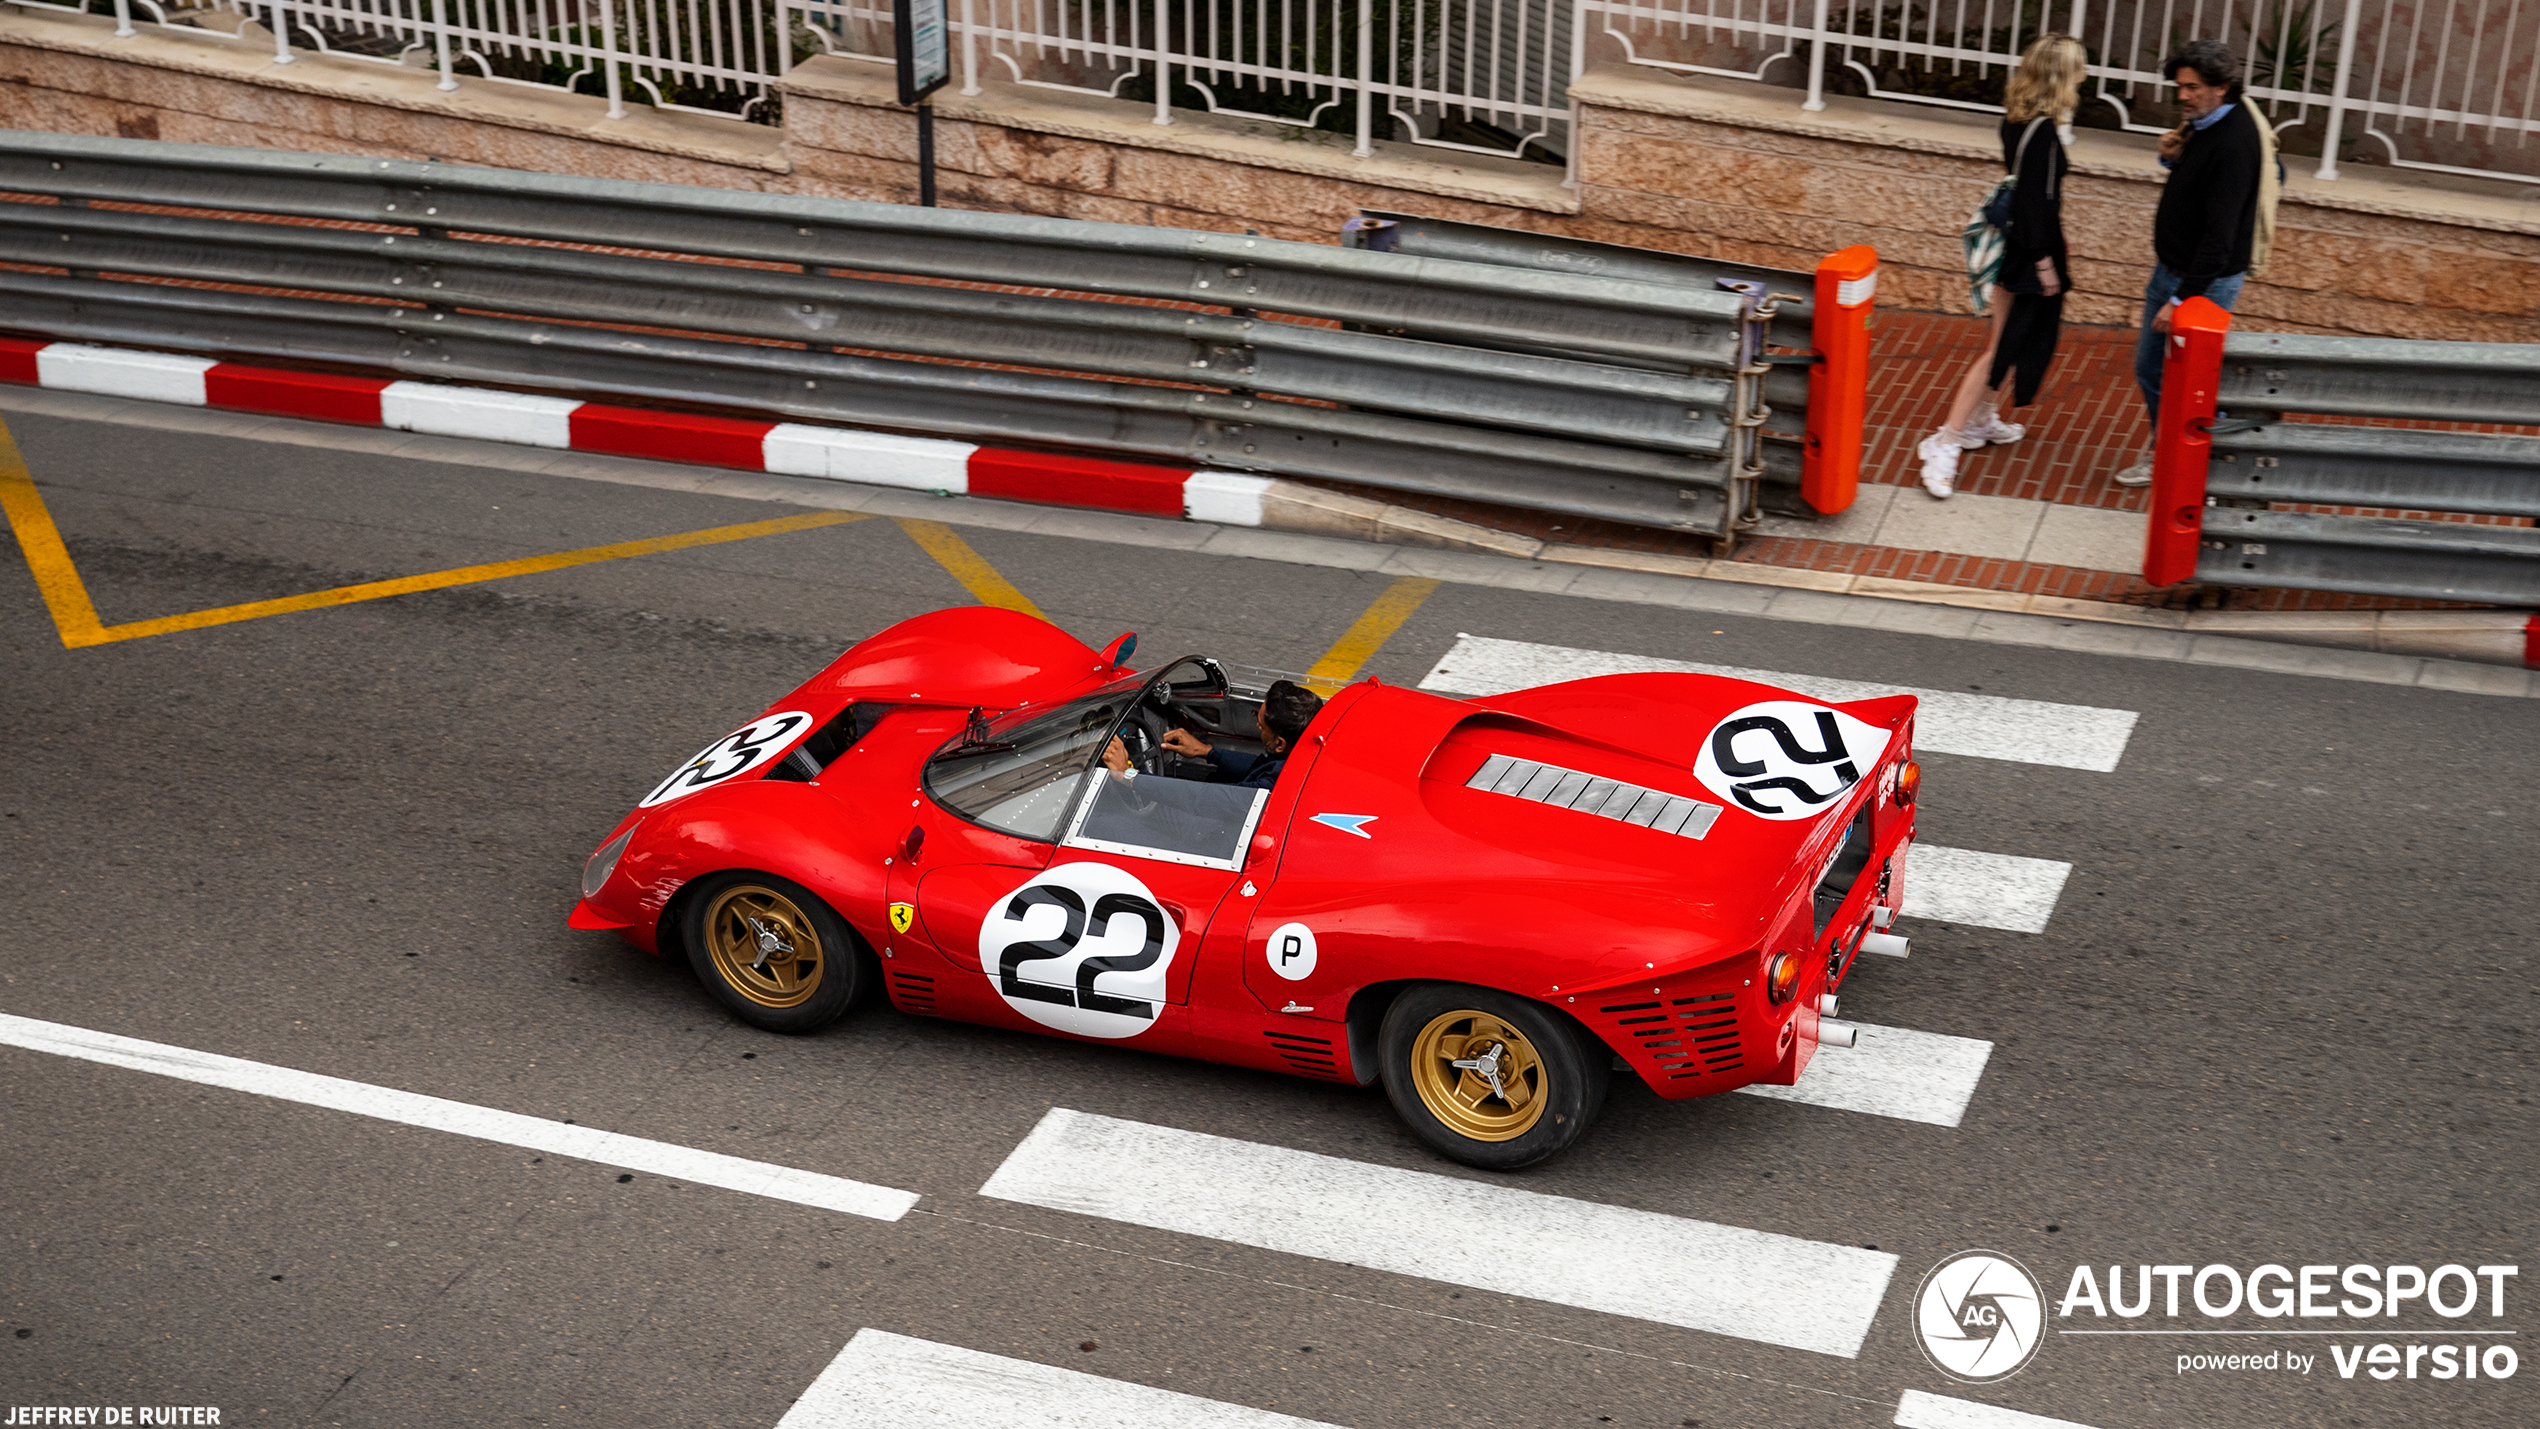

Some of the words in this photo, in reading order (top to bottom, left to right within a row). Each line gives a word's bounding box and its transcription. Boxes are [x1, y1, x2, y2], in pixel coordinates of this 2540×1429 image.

[647, 716, 803, 804] 22
[1711, 711, 1860, 814] 22
[999, 885, 1165, 1020] 22
[1281, 935, 1302, 967] P
